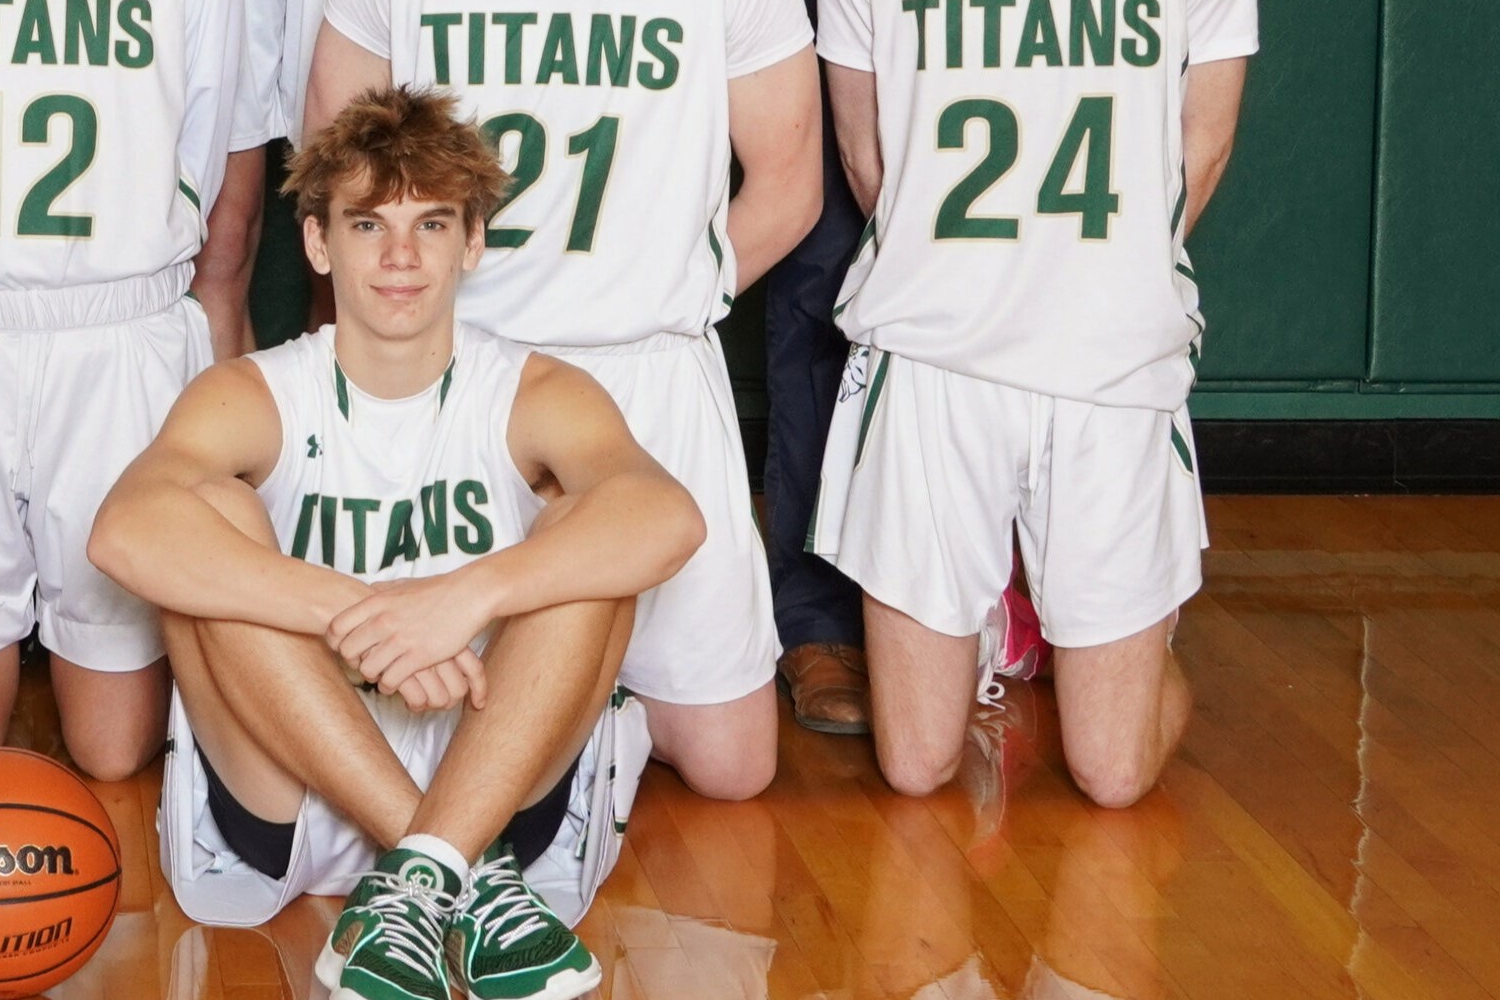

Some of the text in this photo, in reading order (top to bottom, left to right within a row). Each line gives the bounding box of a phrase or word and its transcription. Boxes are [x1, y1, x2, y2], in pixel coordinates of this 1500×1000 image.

[420, 12, 684, 91] TITANS
[478, 110, 622, 255] 21
[931, 93, 1123, 243] 24
